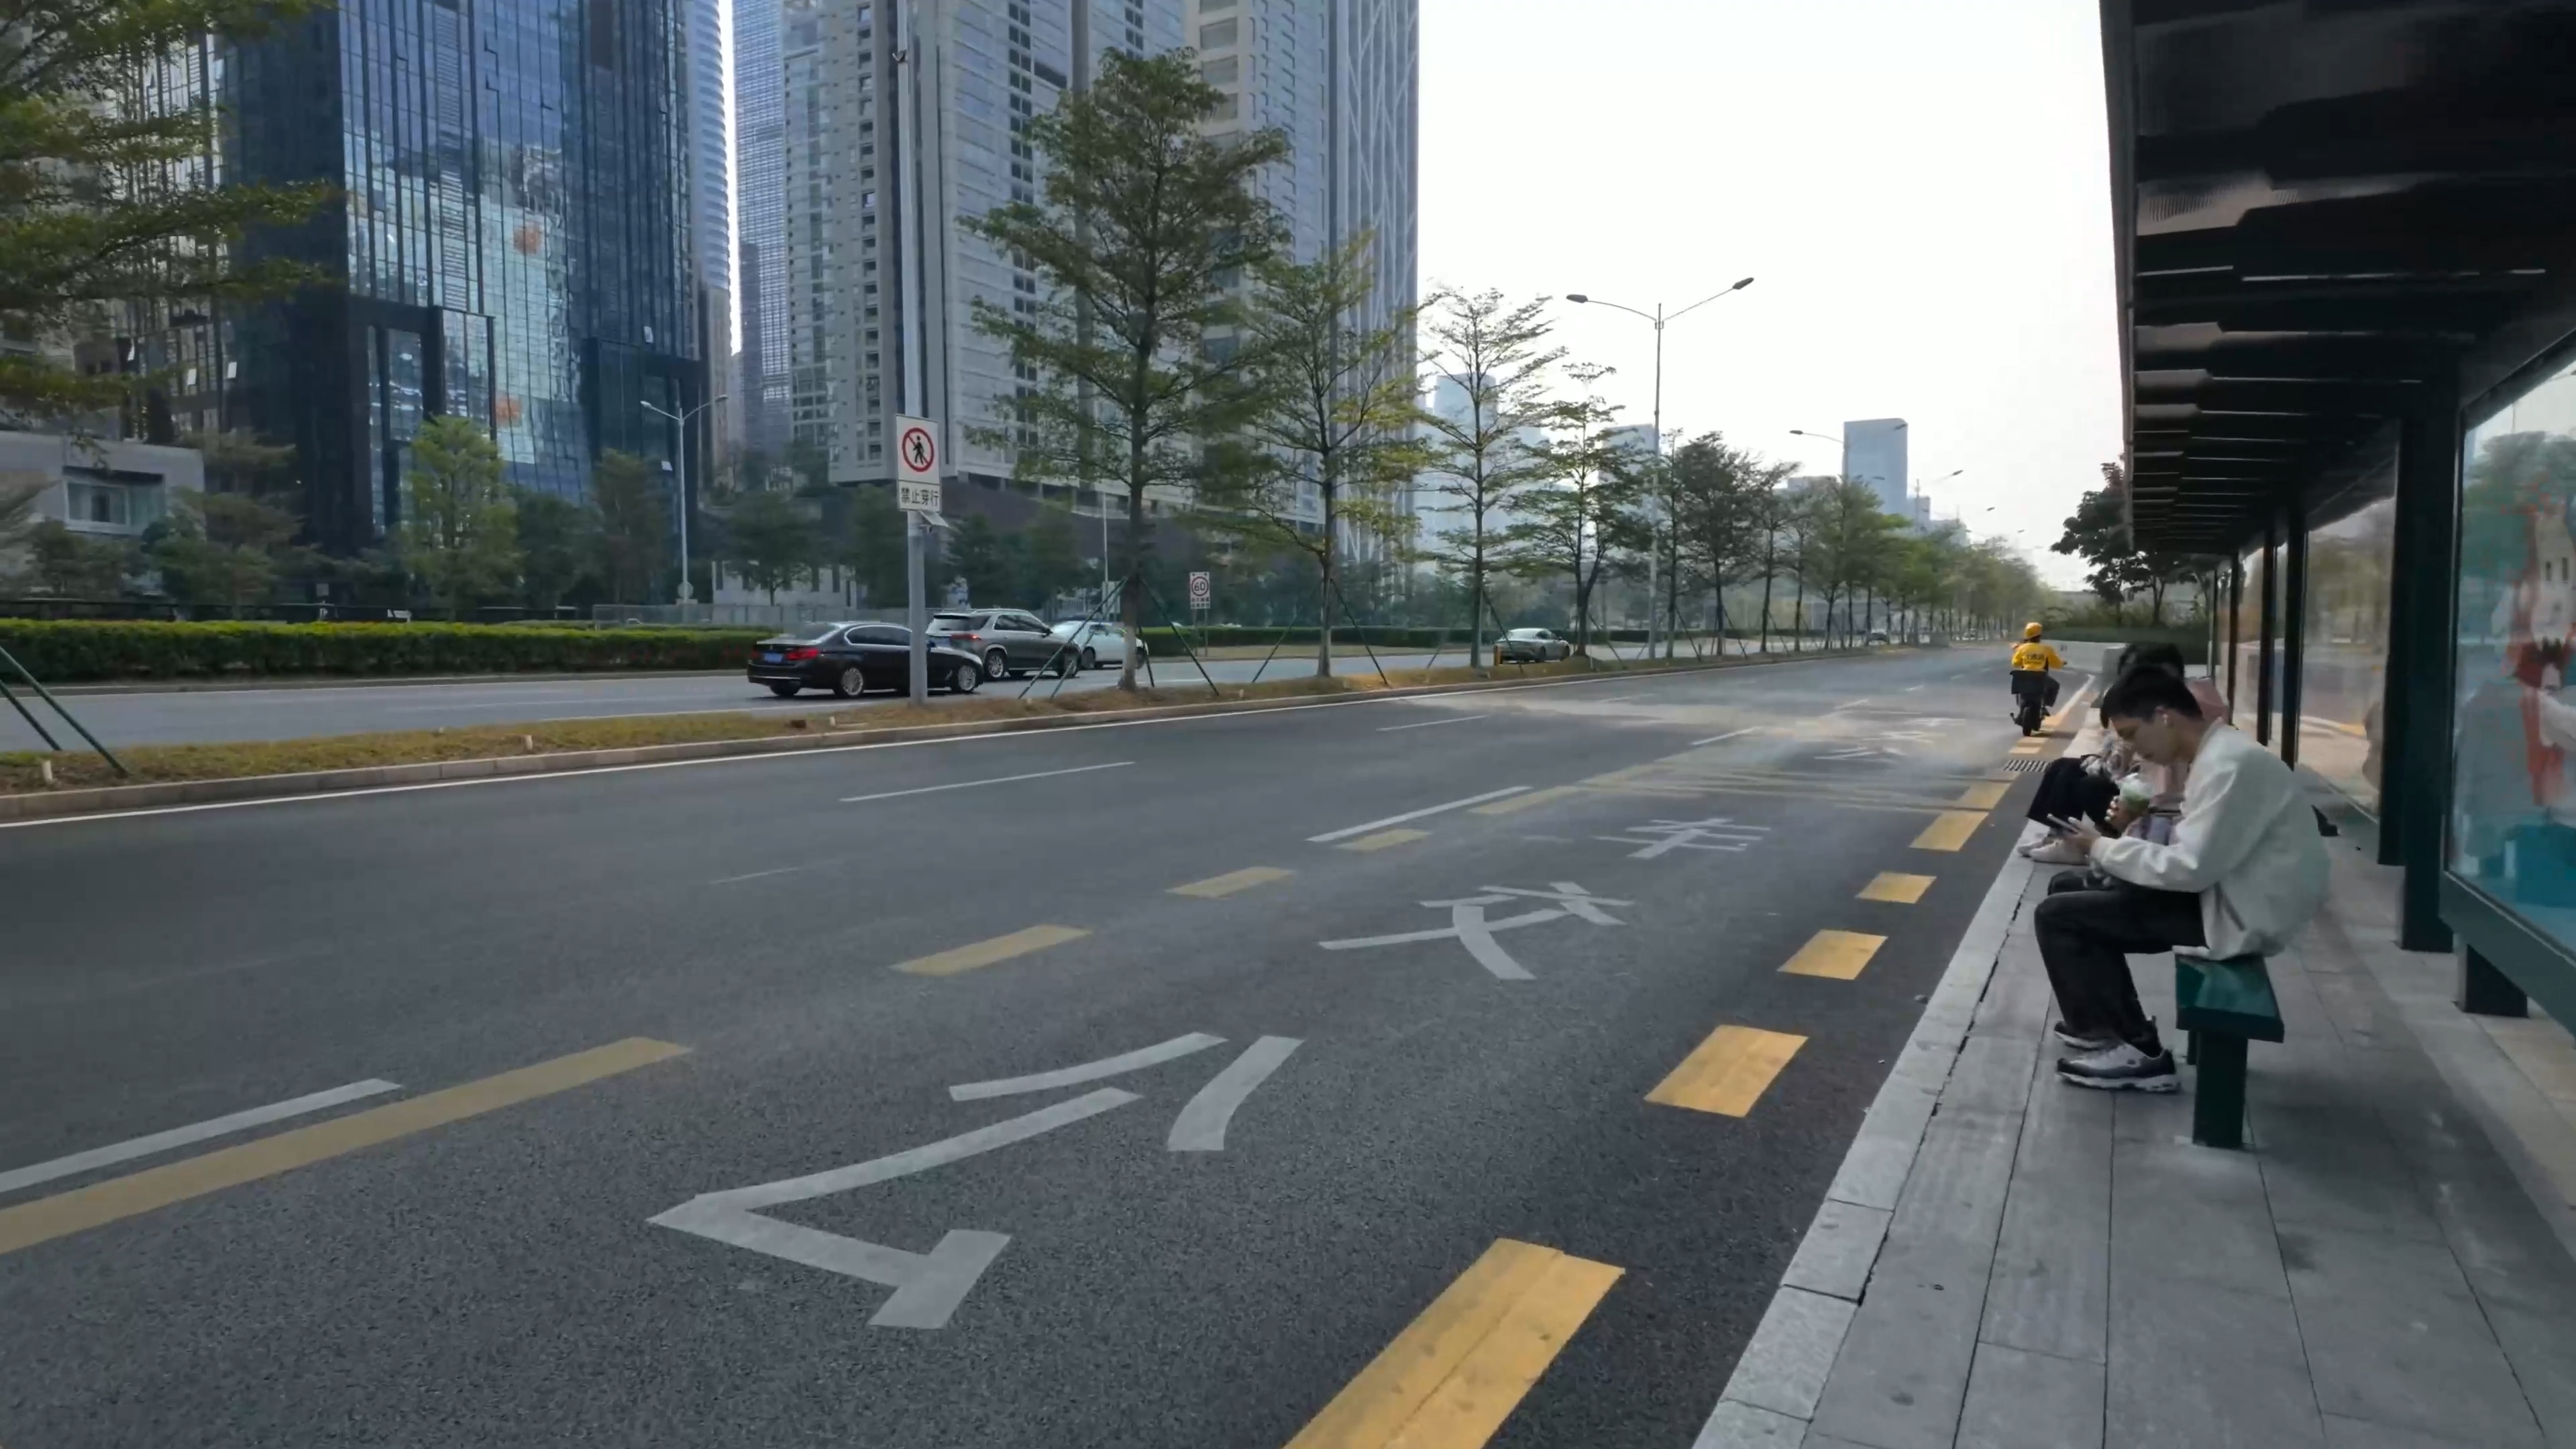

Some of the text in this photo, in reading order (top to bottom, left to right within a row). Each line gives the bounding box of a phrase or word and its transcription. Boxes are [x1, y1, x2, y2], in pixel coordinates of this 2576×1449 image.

[901, 487, 939, 506] 禁止穿行
[1195, 581, 1205, 591] 60
